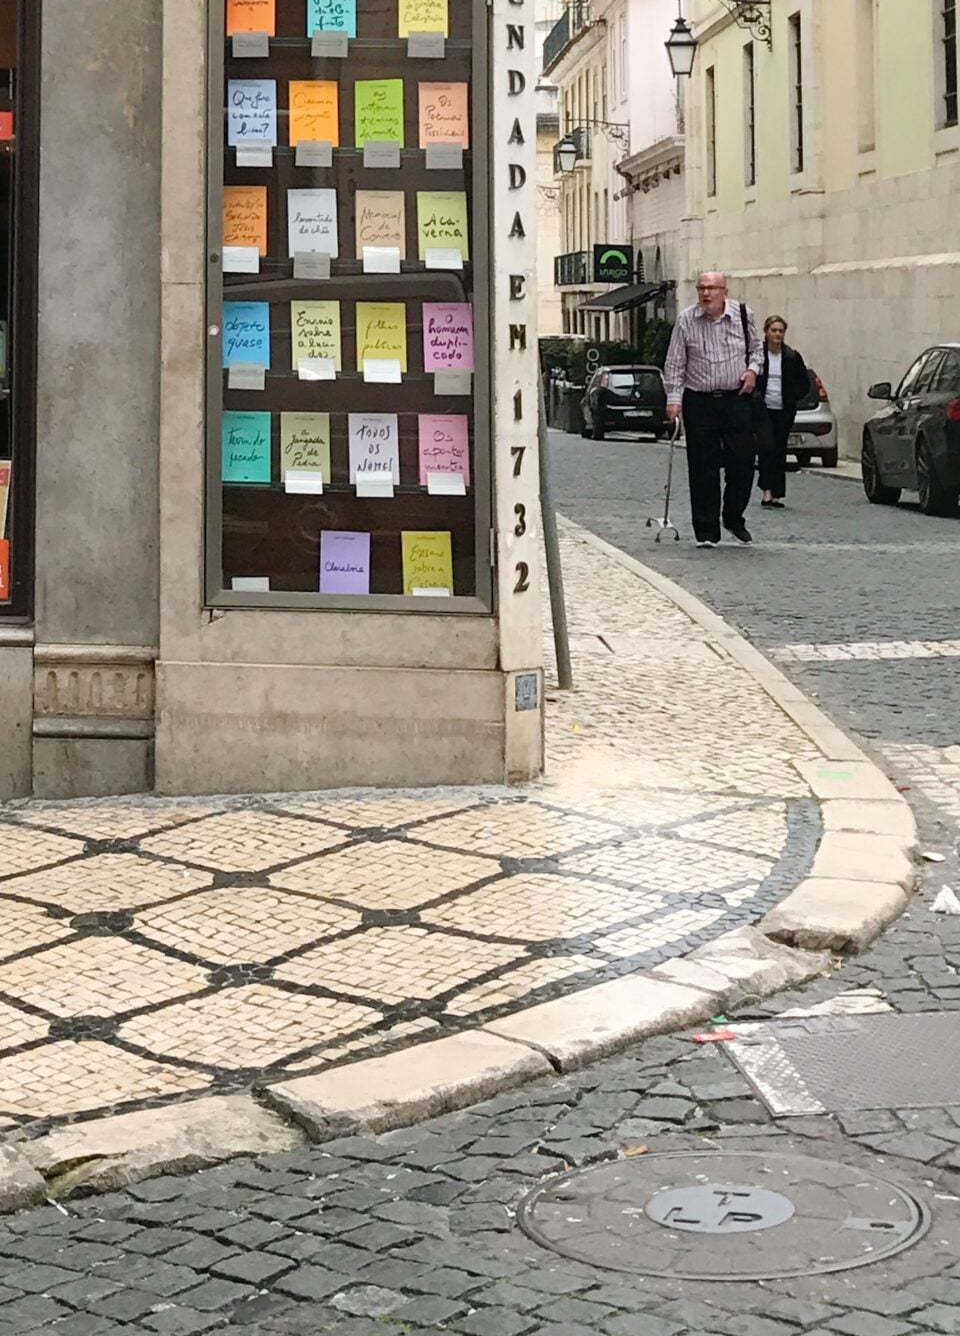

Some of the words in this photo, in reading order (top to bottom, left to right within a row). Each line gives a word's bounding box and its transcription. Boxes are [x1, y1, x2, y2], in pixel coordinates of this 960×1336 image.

[508, 274, 528, 352] EM
[433, 349, 462, 359] cado
[356, 424, 390, 440] TODOS
[510, 388, 529, 593] 1732
